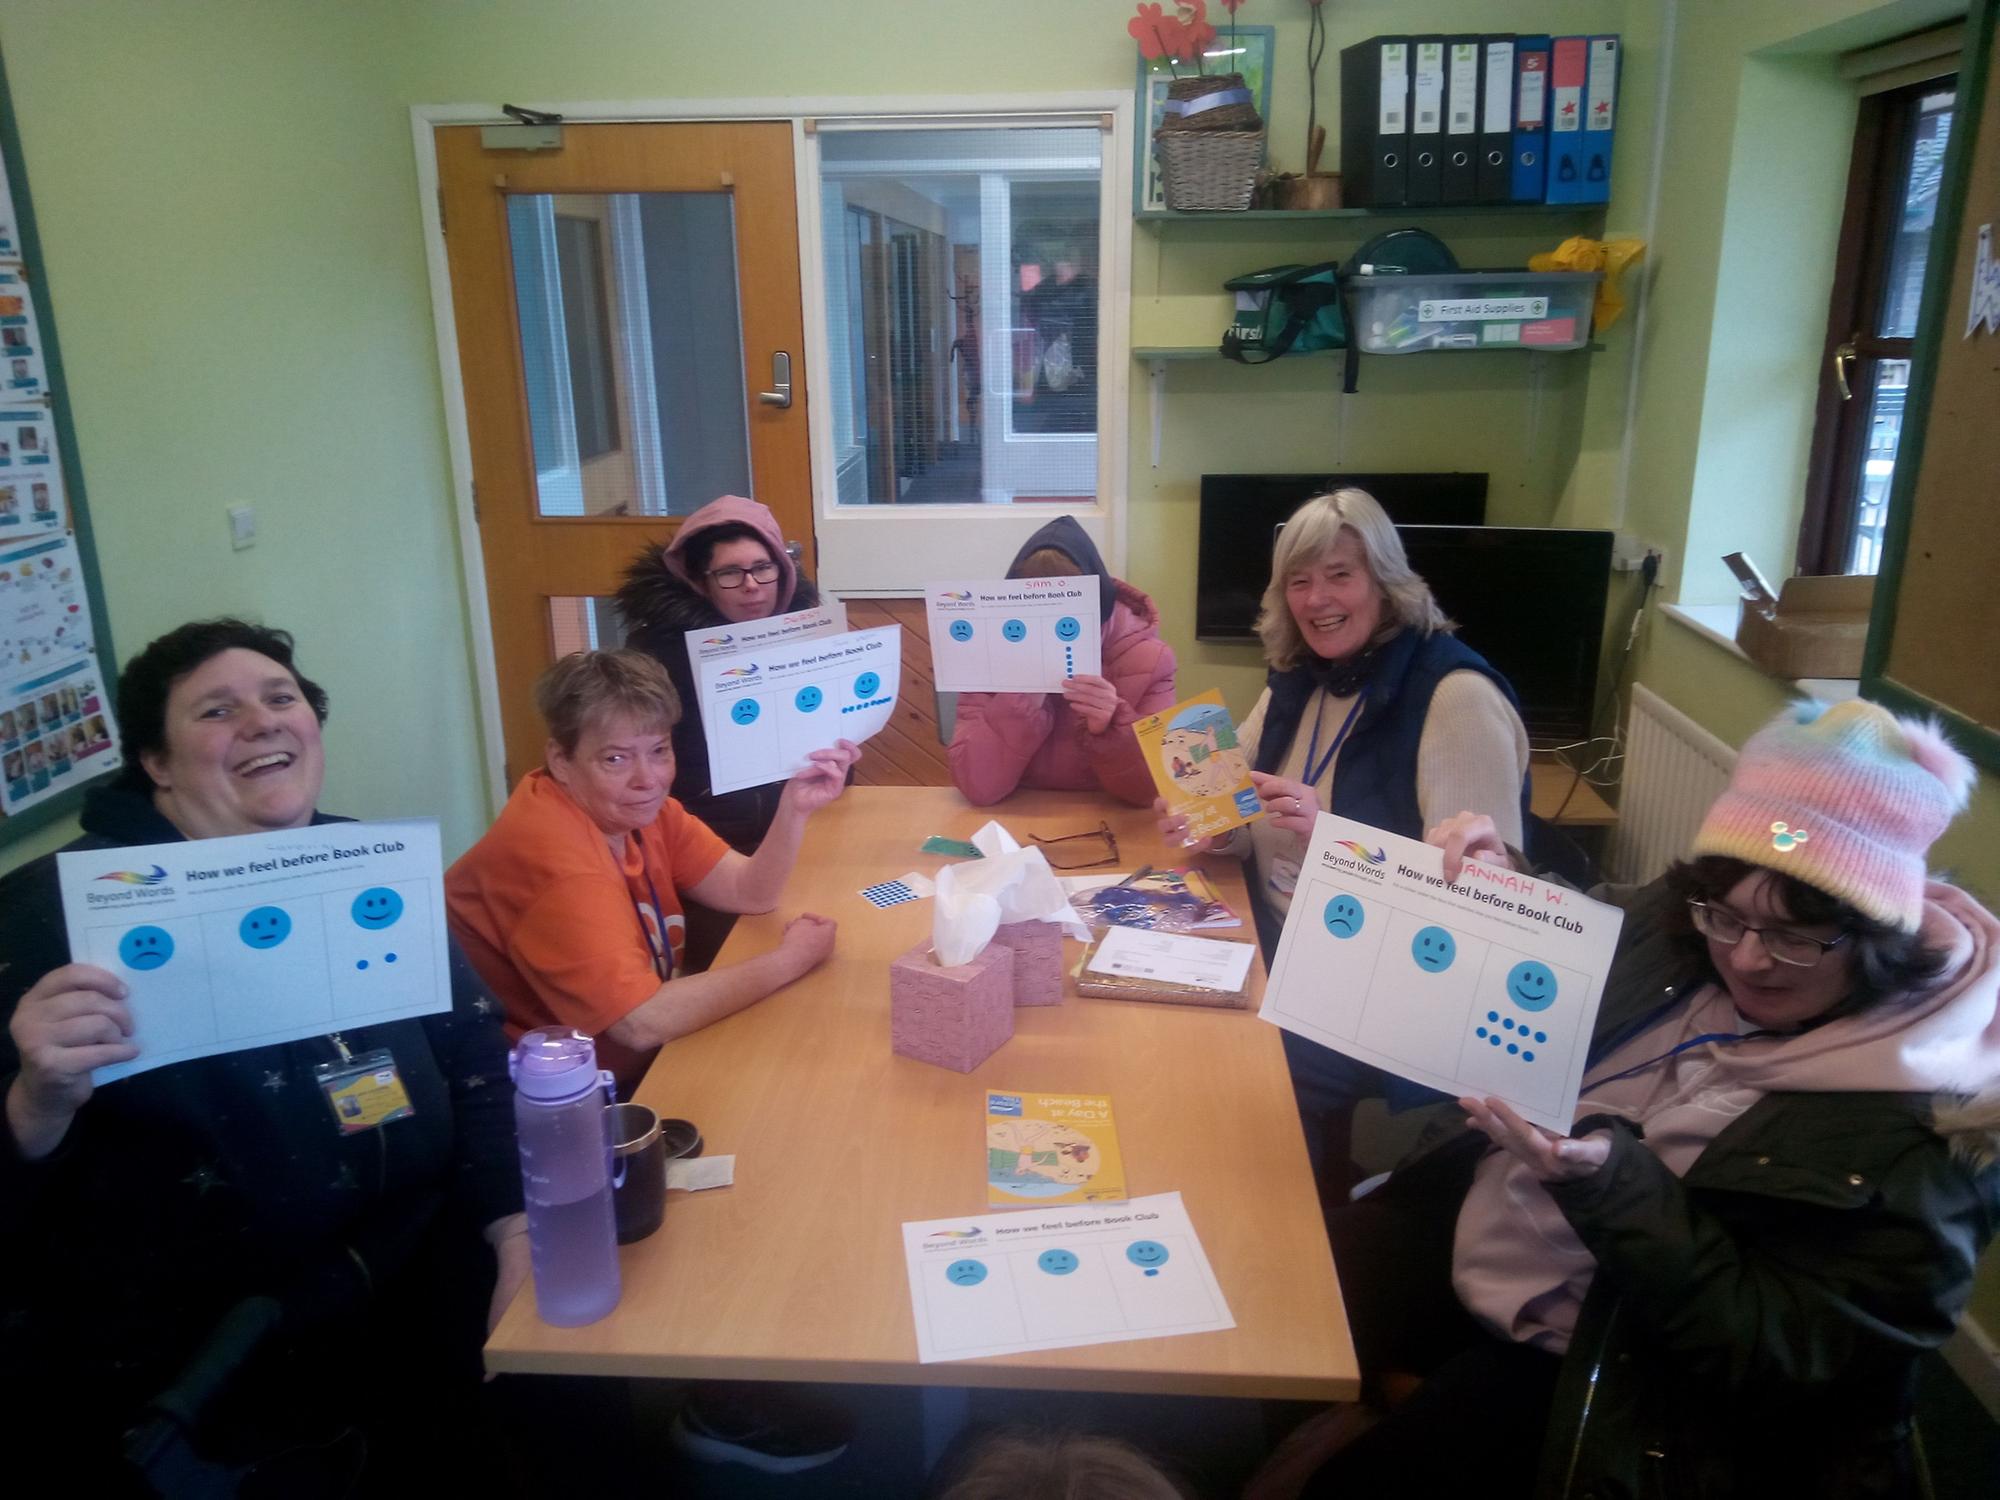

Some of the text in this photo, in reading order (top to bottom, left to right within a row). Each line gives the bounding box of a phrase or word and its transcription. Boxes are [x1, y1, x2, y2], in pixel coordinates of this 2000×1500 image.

[1441, 303, 1525, 314] First Aid Supplies
[1023, 592, 1047, 600] before
[1048, 591, 1066, 599] Book
[1066, 590, 1082, 598] Club
[768, 664, 787, 672] How
[801, 656, 818, 666] feel
[818, 652, 844, 663] before
[866, 640, 884, 651] Club
[186, 870, 220, 882] How
[223, 865, 246, 877] we
[249, 859, 278, 874] feel
[281, 852, 330, 868] before
[333, 845, 370, 860] Book
[373, 840, 406, 855] Club
[1323, 850, 1356, 870] Beyond
[1357, 862, 1386, 880] Words
[86, 886, 176, 904] Beyond Words
[1462, 863, 1535, 897] ANNAH
[1397, 864, 1424, 880] How
[1426, 875, 1444, 888] we
[1473, 889, 1514, 912] before
[1517, 903, 1552, 924] Book
[1553, 916, 1584, 934] Club
[1041, 1222, 1064, 1230] feel
[1065, 1219, 1102, 1228] before
[1104, 1216, 1132, 1224] Book
